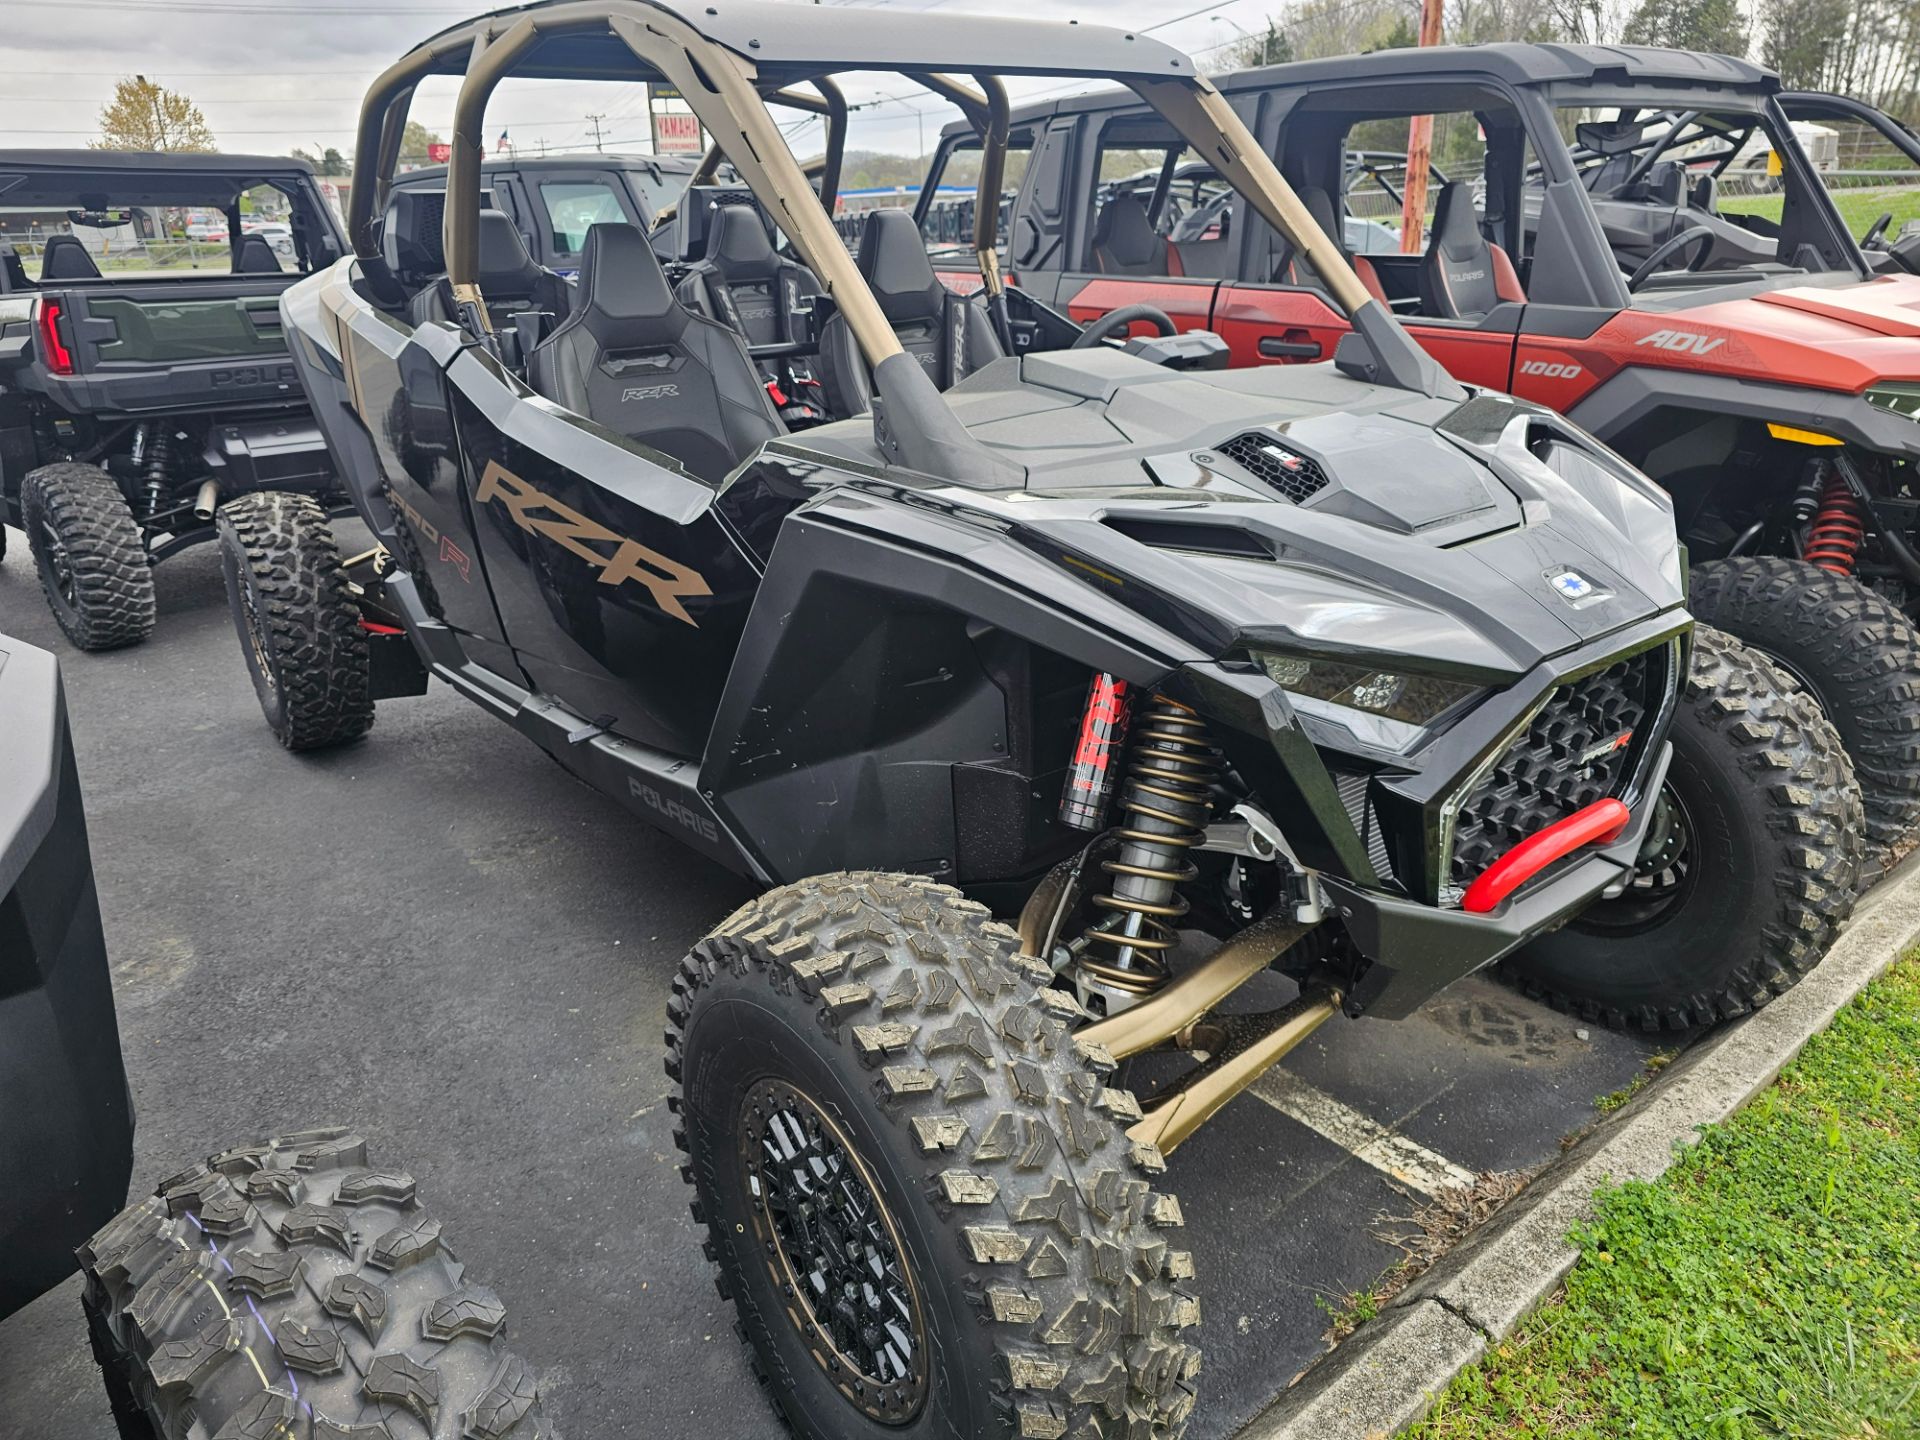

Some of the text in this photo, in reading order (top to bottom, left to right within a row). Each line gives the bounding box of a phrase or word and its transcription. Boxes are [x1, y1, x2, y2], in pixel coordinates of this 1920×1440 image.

[657, 115, 699, 138] YAMAHA
[1635, 329, 1725, 355] ADV
[1520, 360, 1582, 379] 1000
[621, 383, 679, 402] RZR
[475, 458, 714, 629] RZR
[440, 535, 471, 584] R
[627, 776, 719, 842] POLARIS
